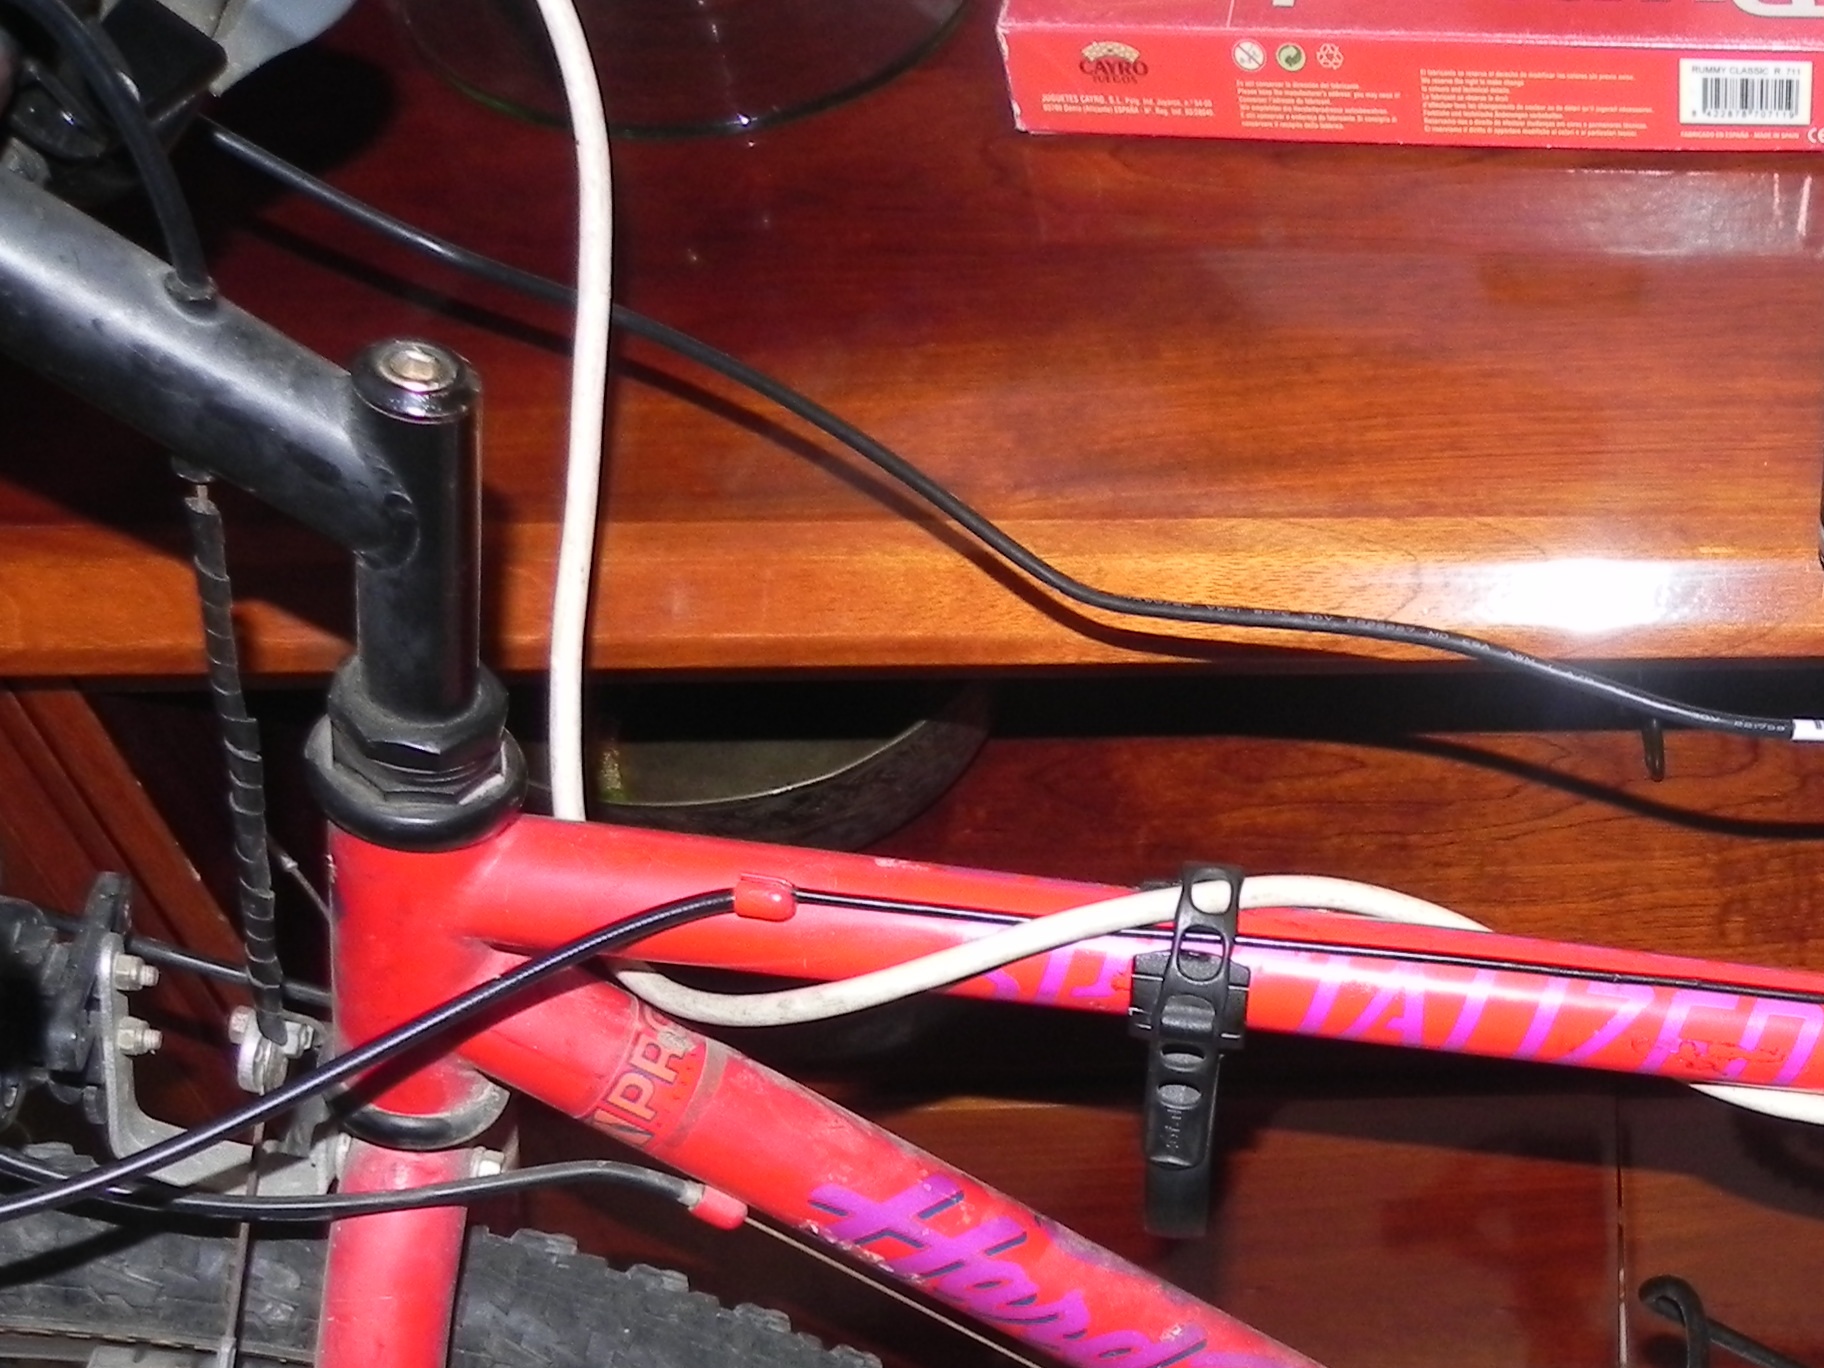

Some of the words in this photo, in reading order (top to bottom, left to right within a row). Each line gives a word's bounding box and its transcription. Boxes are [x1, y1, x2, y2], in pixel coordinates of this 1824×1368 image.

[1079, 60, 1149, 77] CAYRO
[1691, 65, 1726, 75] RUMMY
[1729, 67, 1769, 76] CLASSIC
[1786, 68, 1802, 76] 711
